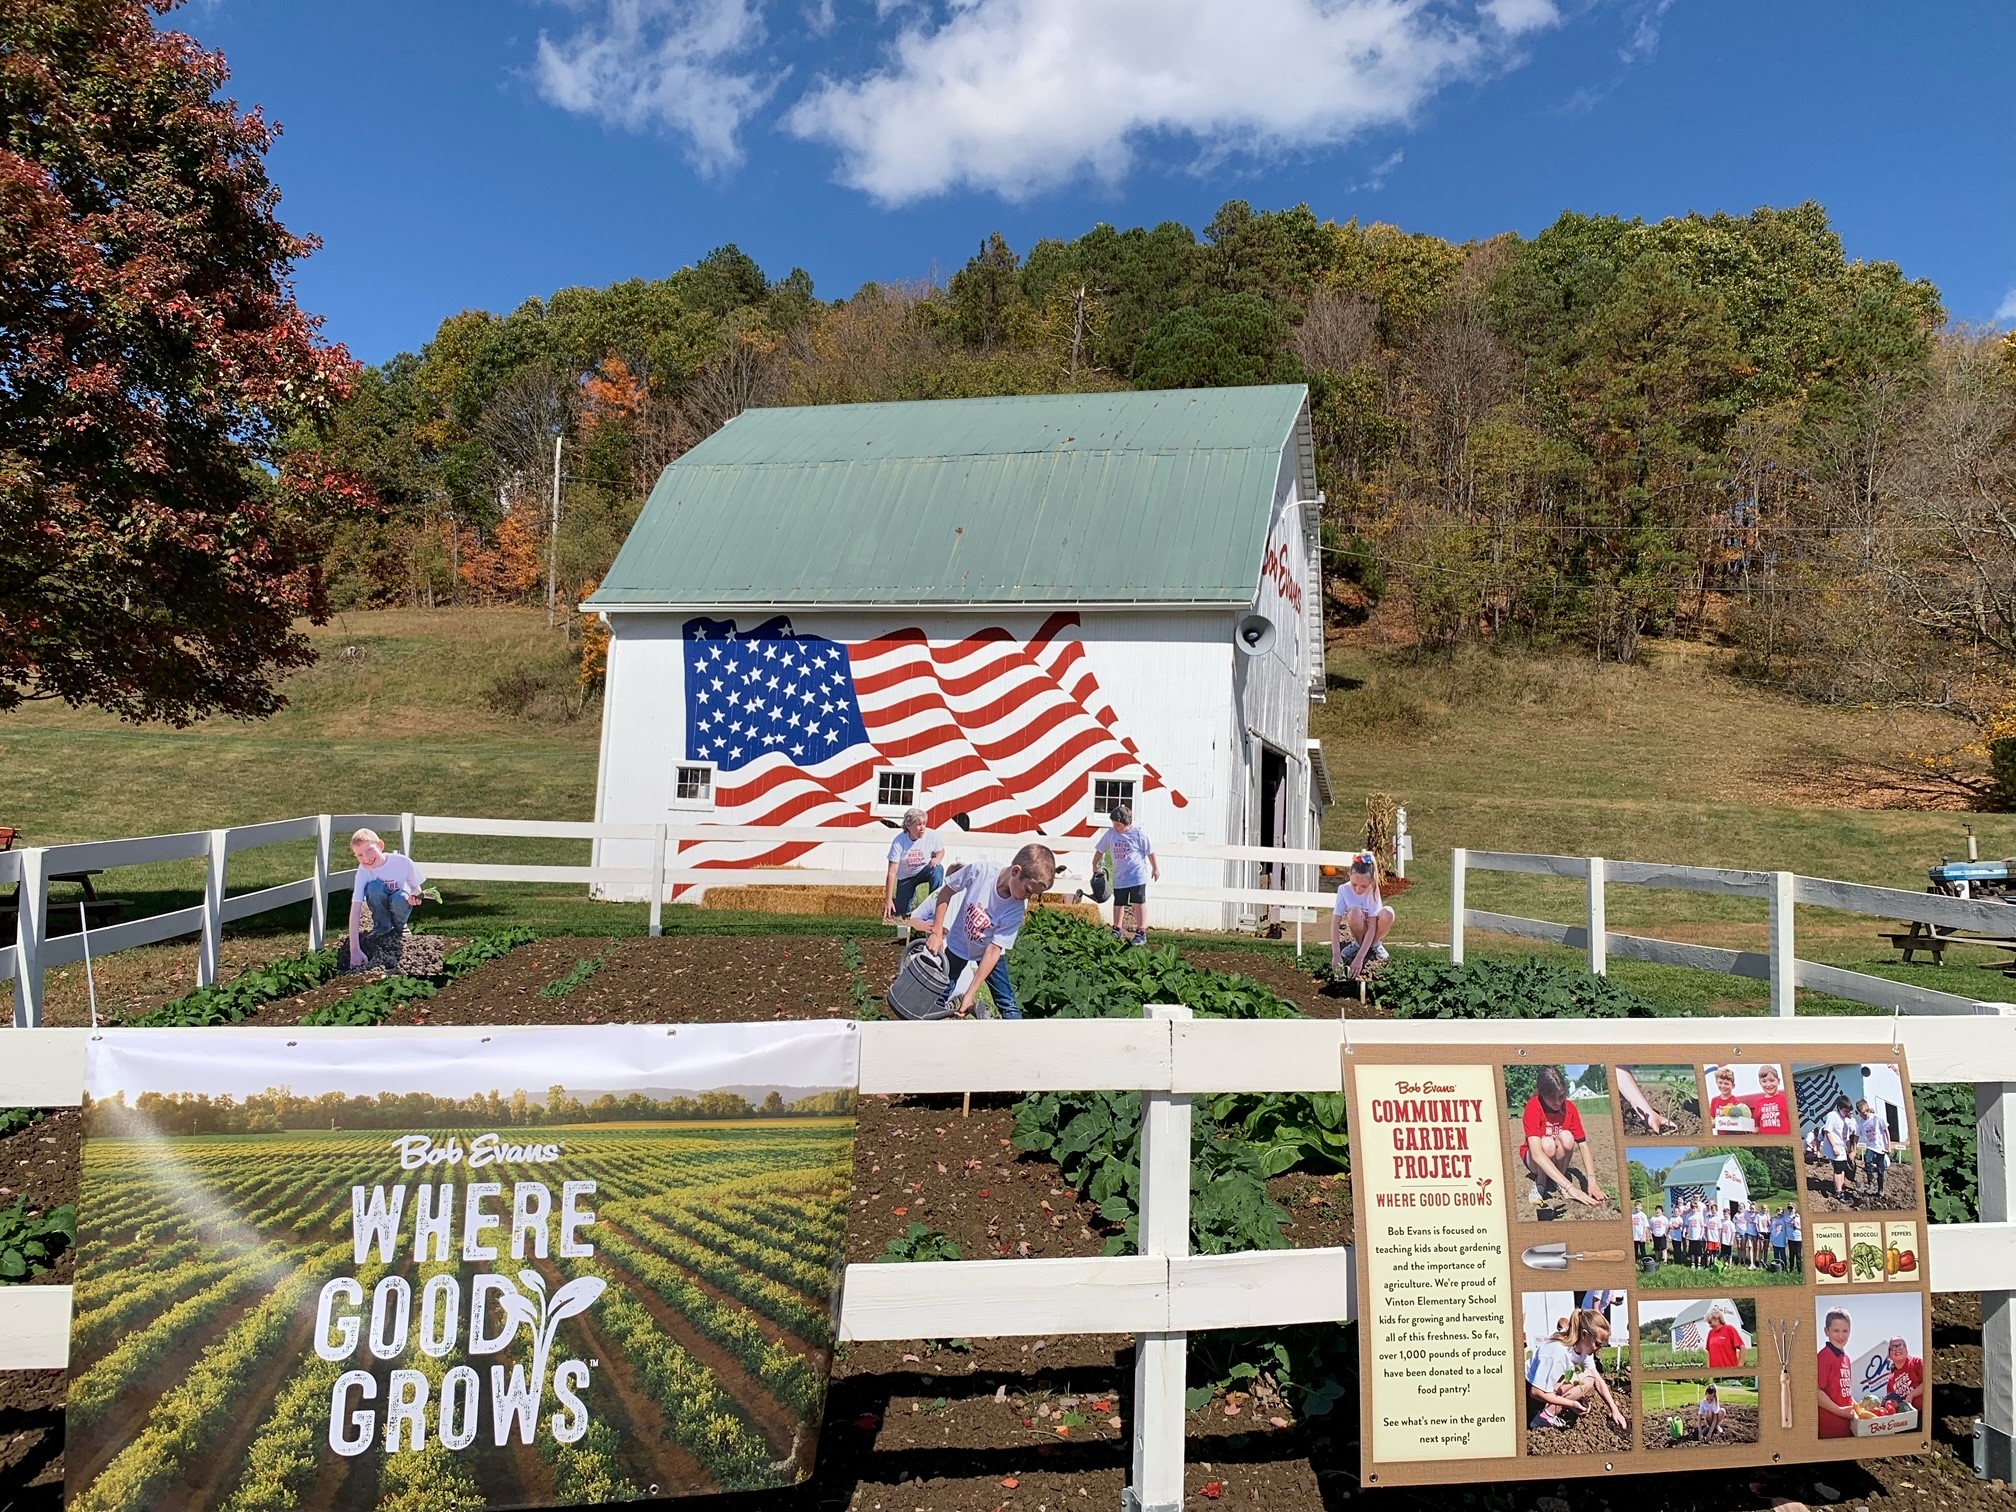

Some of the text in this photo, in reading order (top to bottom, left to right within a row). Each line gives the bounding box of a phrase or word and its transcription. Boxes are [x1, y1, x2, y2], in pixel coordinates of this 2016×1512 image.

[1394, 1080, 1456, 1095] Bob Evans
[1371, 1099, 1483, 1124] COMMUNITY
[1393, 1127, 1469, 1151] GARDEN
[392, 1133, 560, 1170] Bob Evans
[1393, 1155, 1472, 1180] PROJECT
[1376, 1191, 1493, 1208] WHERE GOOD GROWS
[352, 1180, 597, 1264] WHERE
[1387, 1224, 1488, 1236] Bob Evans is focused on
[1375, 1242, 1502, 1257] teaching kids about gardening
[1392, 1259, 1487, 1274] and the importance of
[1383, 1276, 1497, 1293] agriculture. We're proud of
[1384, 1294, 1497, 1309] Vinton Elementary School
[314, 1273, 520, 1362] GOOD
[1378, 1311, 1505, 1328] kids for growing and harvesting
[1385, 1329, 1500, 1343] all of this freshness. So far,
[1378, 1346, 1507, 1363] over 1,000 pounds of produce
[1383, 1368, 1404, 1378] have
[1405, 1367, 1427, 1378] been
[1428, 1365, 1464, 1377] donated
[1465, 1367, 1475, 1375] to
[1483, 1364, 1503, 1375] local
[1417, 1383, 1471, 1398] food pantry!
[328, 1359, 591, 1457] GROWS
[1383, 1413, 1506, 1427] See what's new in the garden
[1868, 1420, 1909, 1434] Bob Evans
[1419, 1431, 1471, 1446] next spring!
